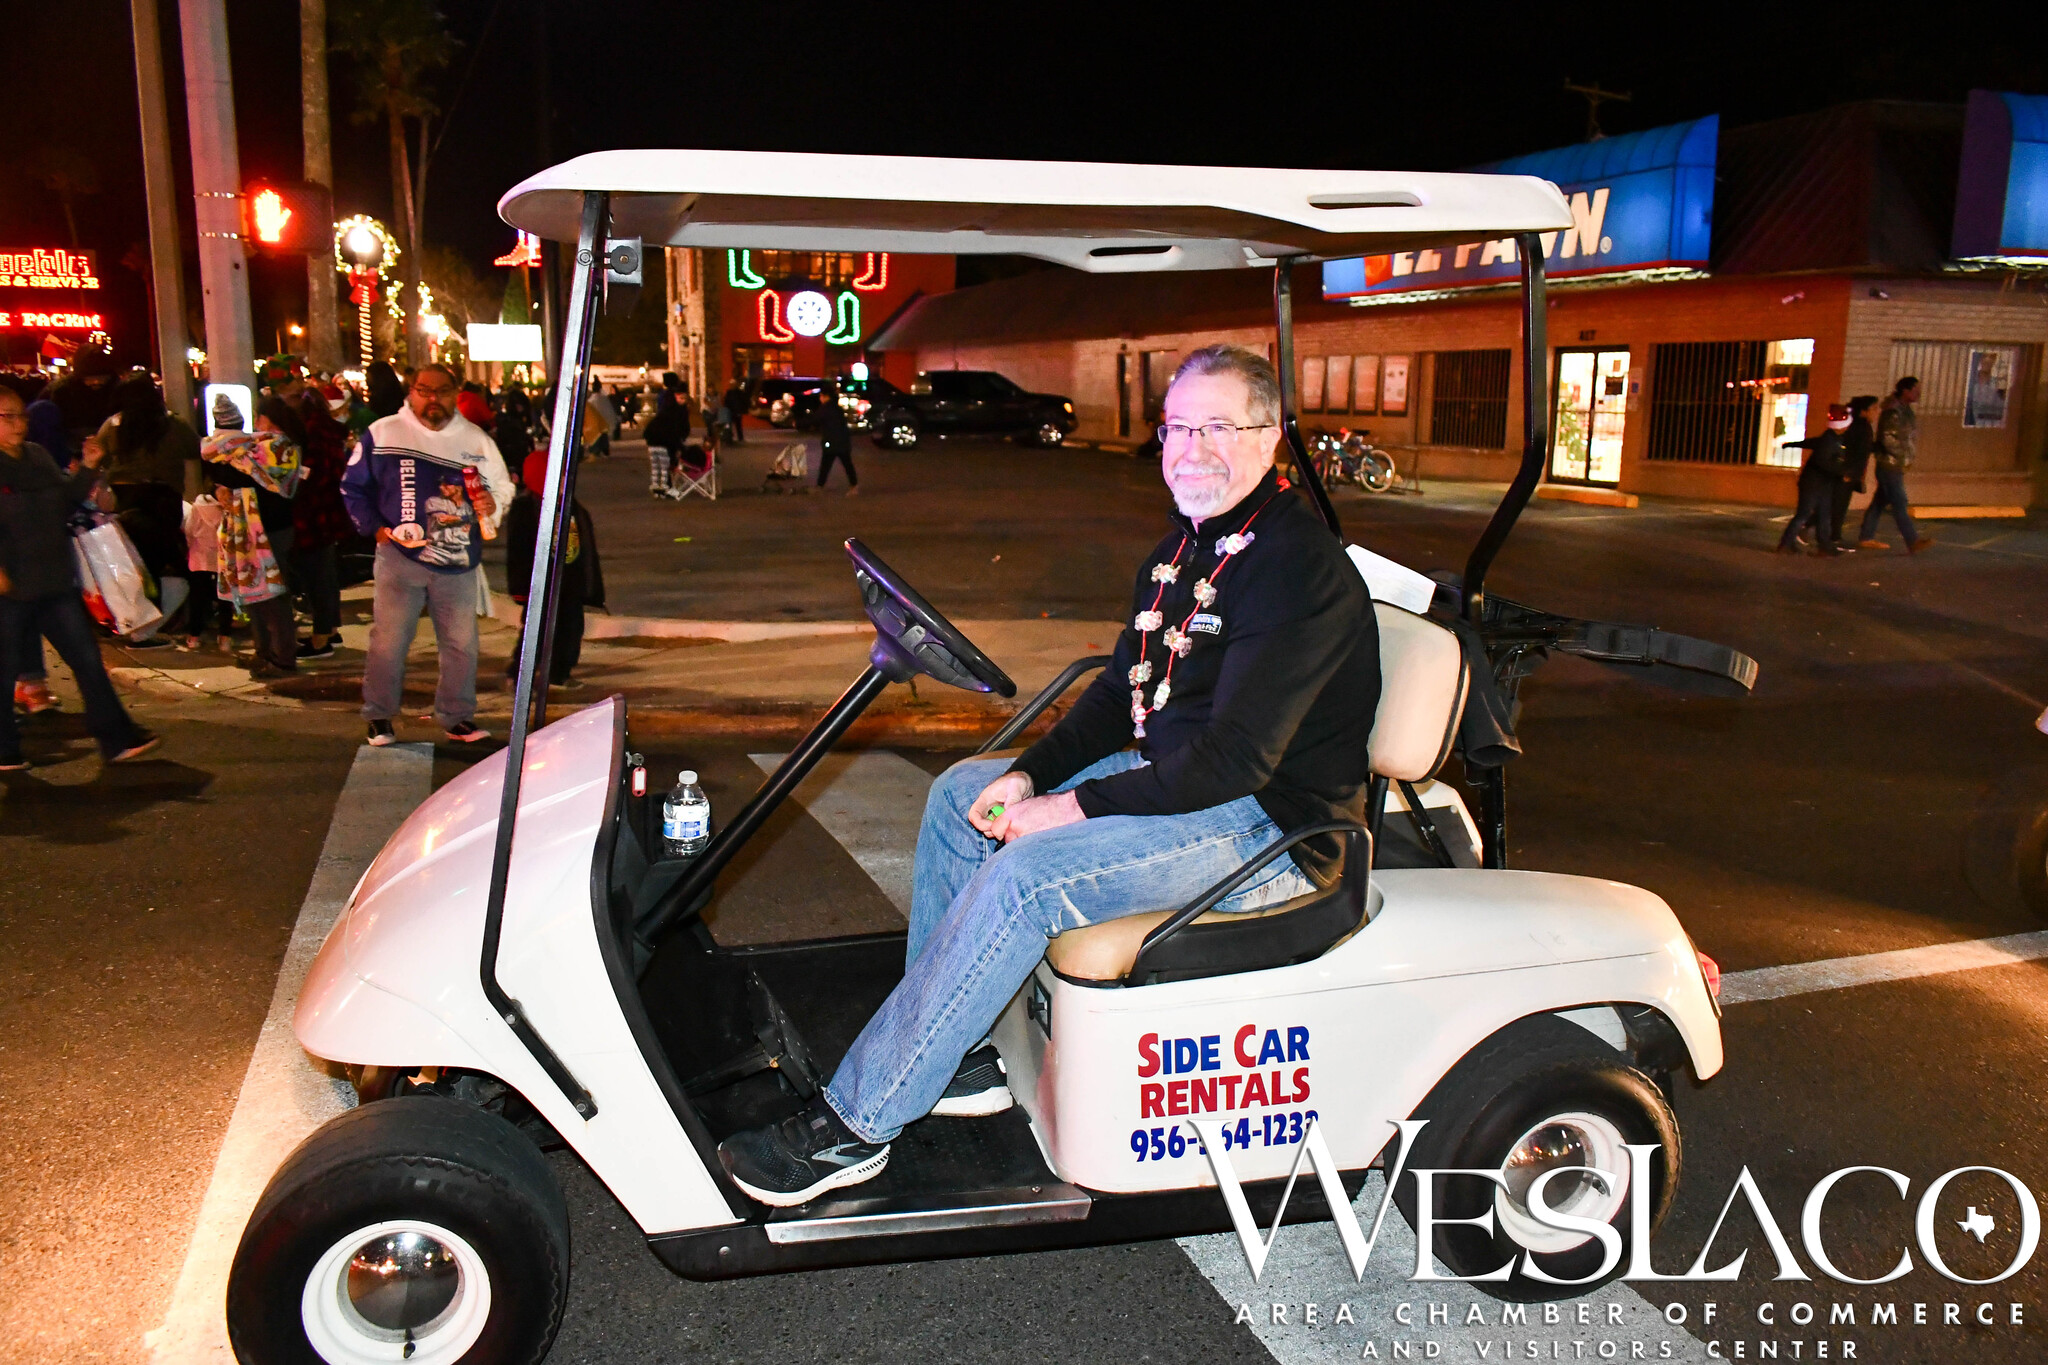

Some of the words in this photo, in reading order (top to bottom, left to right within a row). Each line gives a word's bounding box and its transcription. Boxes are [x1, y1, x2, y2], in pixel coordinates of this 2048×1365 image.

[400, 458, 416, 522] BELLINGER
[1137, 1032, 1221, 1078] SIDE
[1233, 1024, 1311, 1069] CAR
[1140, 1067, 1311, 1119] RENTALS
